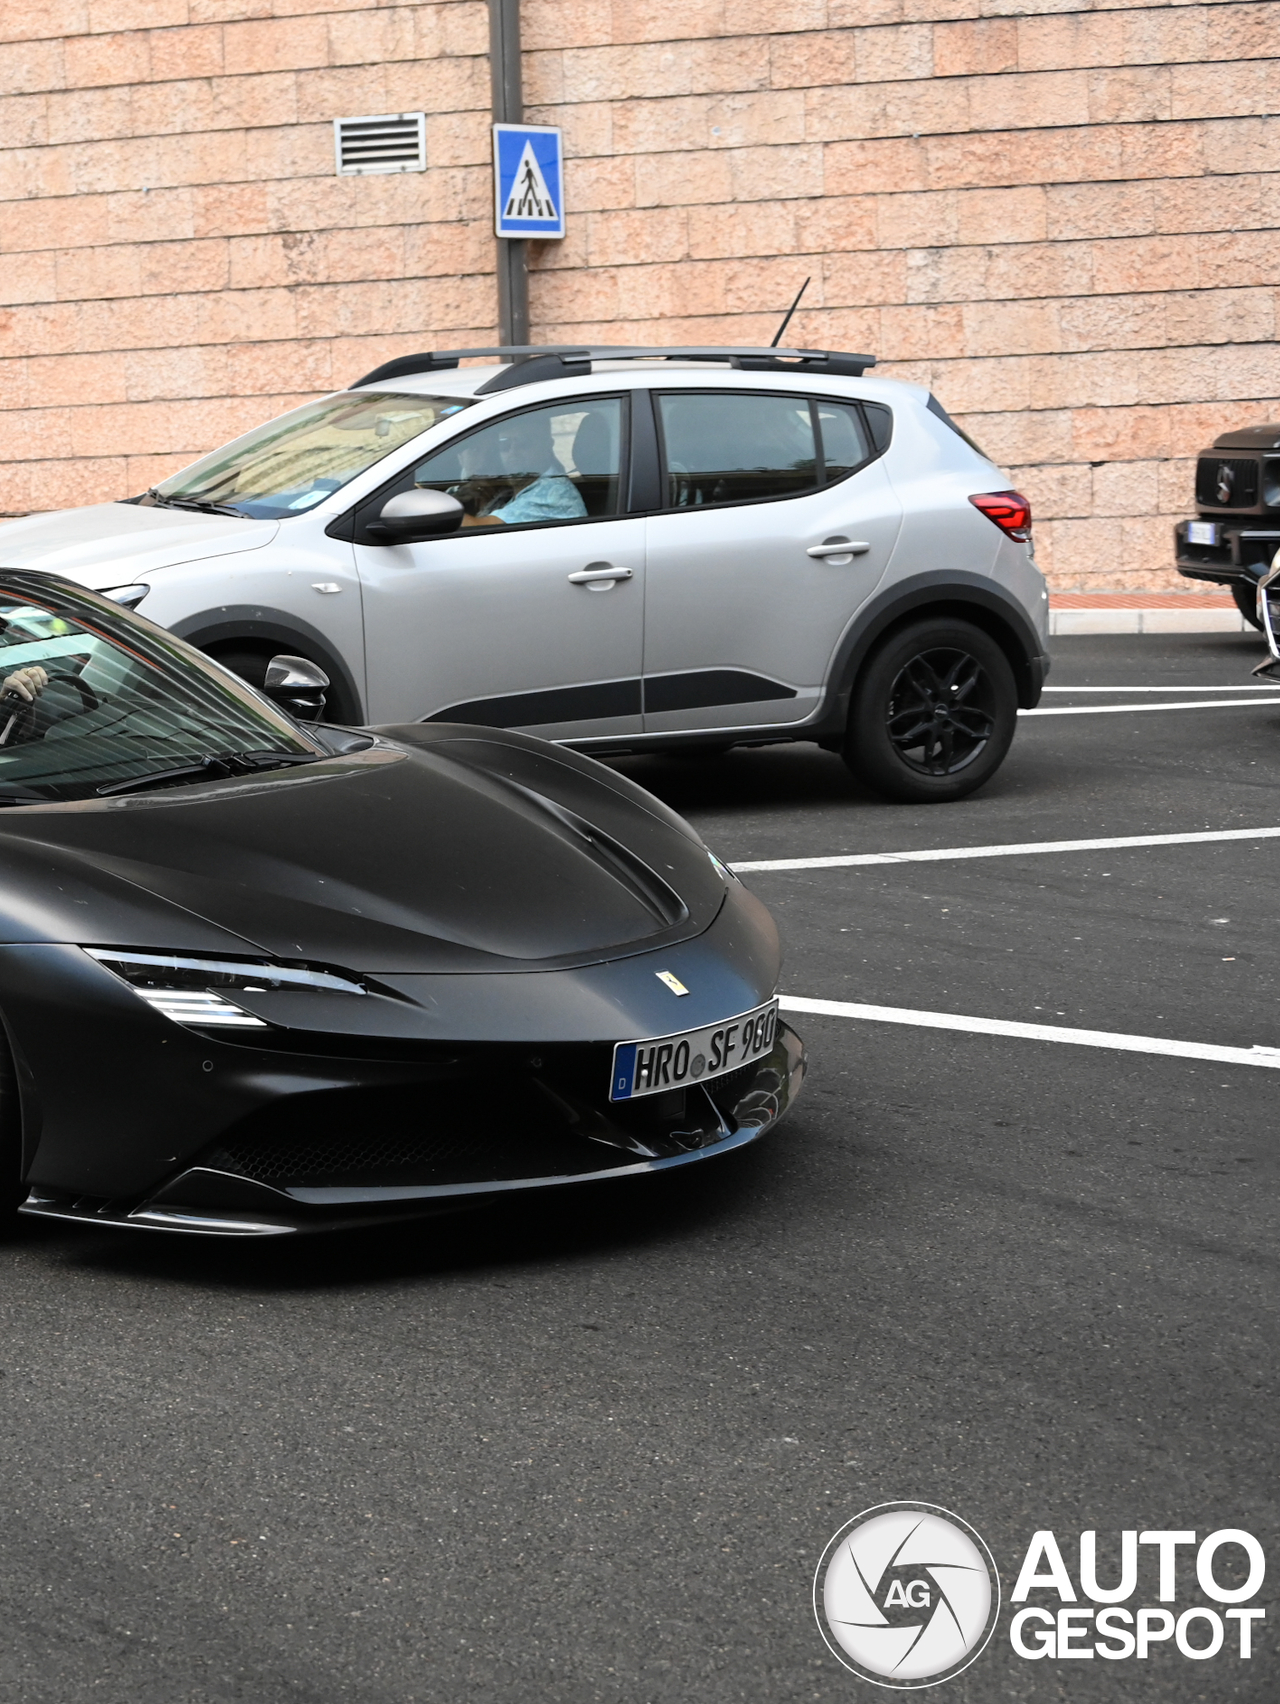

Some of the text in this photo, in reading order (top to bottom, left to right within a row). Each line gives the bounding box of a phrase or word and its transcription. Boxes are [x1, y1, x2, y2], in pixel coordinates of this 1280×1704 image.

[618, 1077, 626, 1090] D
[634, 1040, 690, 1090] HRO
[708, 1023, 739, 1072] SF
